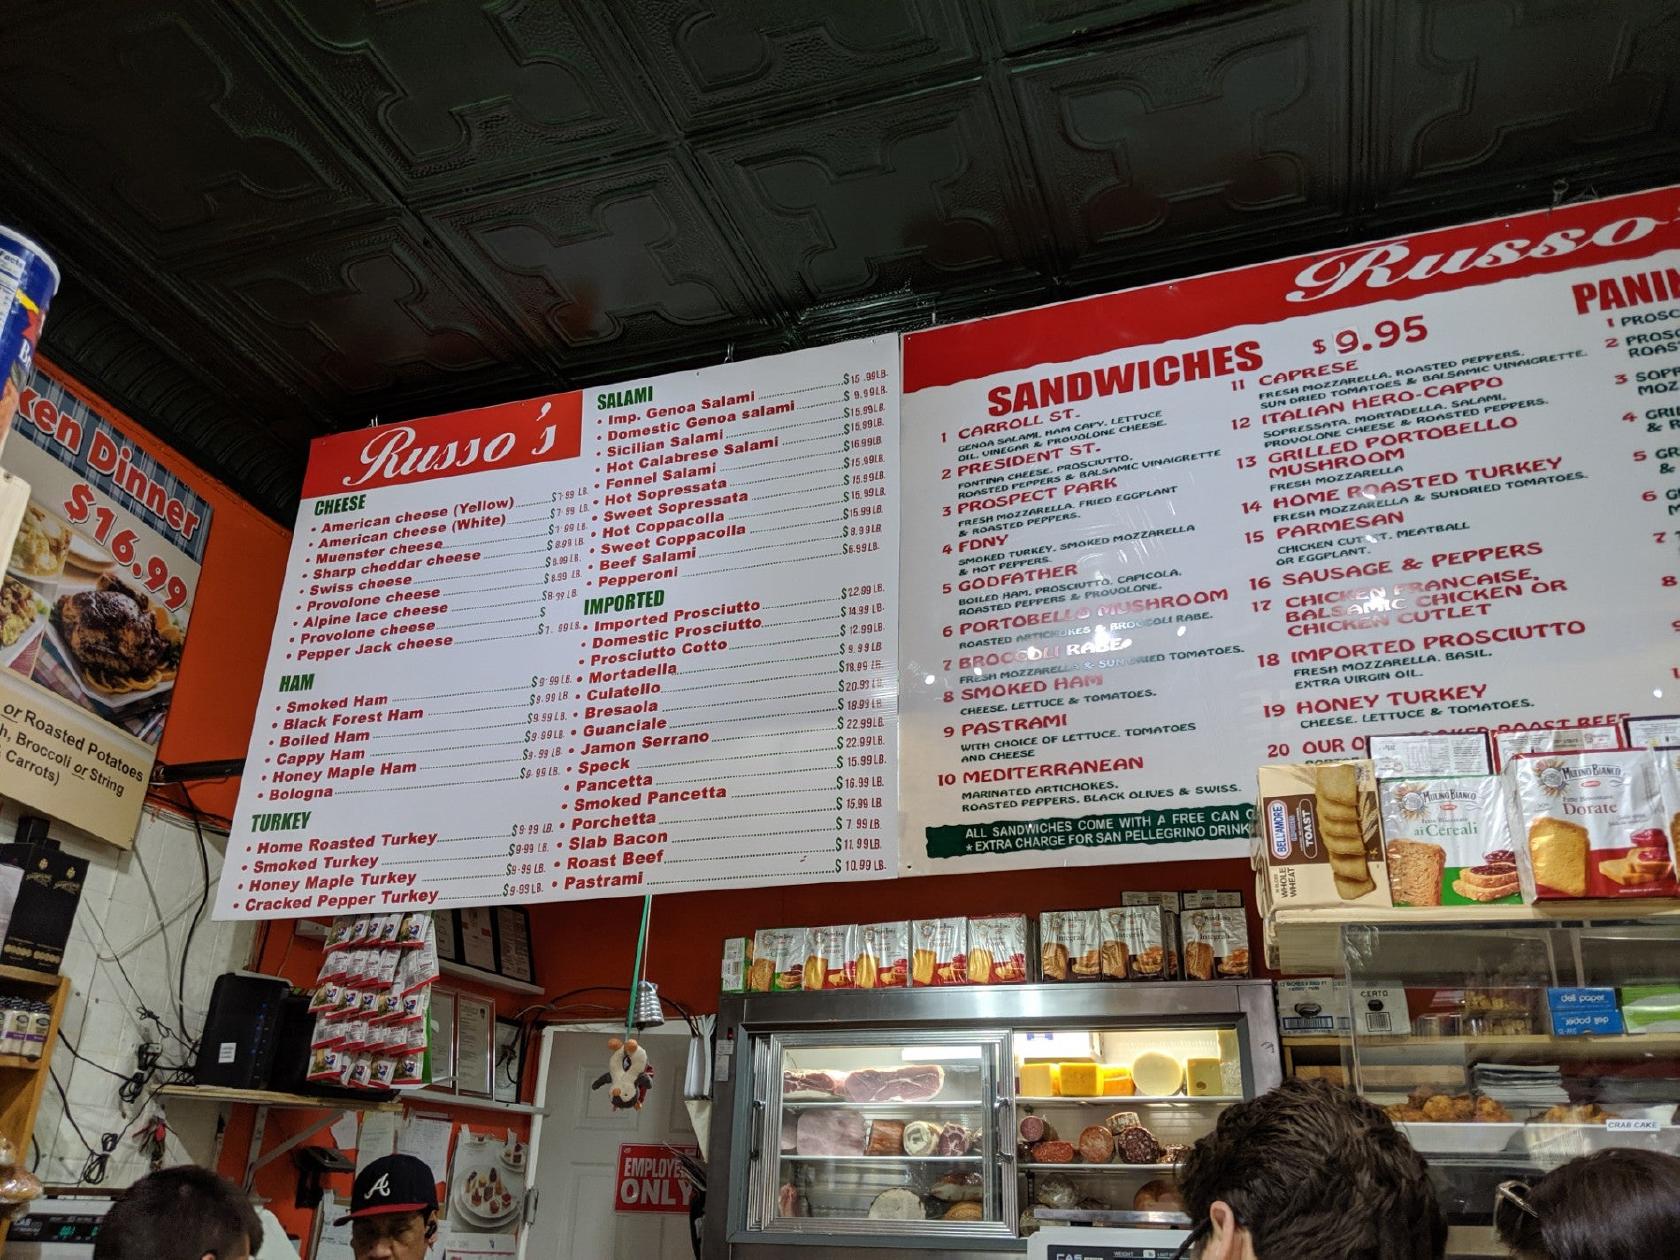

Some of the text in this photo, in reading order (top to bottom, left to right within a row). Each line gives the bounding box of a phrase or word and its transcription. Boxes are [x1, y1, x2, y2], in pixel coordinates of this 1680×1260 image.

[1312, 315, 1429, 355] $9.95
[988, 341, 1263, 417] SANDWICHES
[1259, 360, 1358, 386] CAPRESE
[597, 386, 653, 410] SALAMI
[1260, 379, 1402, 409] SUN DRIED TOMATOES
[1262, 377, 1503, 425] ITALIAN HERO-CAPPO
[608, 391, 755, 425] Imp. Genoa Salami
[608, 400, 795, 441] Domestic Genoa salami
[958, 408, 1080, 439] CARROLL ST.
[958, 410, 1162, 452] GENOA LETTUCE
[1268, 416, 1518, 463] GRILLED PORTOBELLO
[958, 442, 1101, 477] PRESIDENT ST.
[1269, 447, 1405, 478] MUSHROOM
[1633, 451, 1647, 462] 5
[87, 430, 200, 538] Dinner
[958, 484, 1009, 500] ROASTED
[1011, 476, 1061, 490] PEPPERS
[1079, 462, 1138, 478] BALSAMIC
[1273, 457, 1562, 509] HOME ROASTED TURKEY
[314, 494, 366, 516] CHEESE
[603, 492, 748, 522] Sweet Sopressata
[958, 477, 1117, 514] PROSPECT PARK
[1079, 486, 1178, 508] FRIED EGGPLANT
[321, 496, 514, 533] American cheese (Yellow)
[602, 511, 724, 539] Hot Coppacolla
[1277, 511, 1404, 539] PARMESAN
[63, 483, 188, 612] $16.99
[959, 534, 1009, 553] FDNY
[1060, 525, 1195, 550] SMOKED MOZZARELLA
[316, 540, 443, 564] Muenster cheese
[1282, 542, 1543, 586] SAUSAGE & PEPPERS
[598, 566, 678, 588] Pepperoni
[958, 564, 1078, 592] GODFATHER
[1661, 575, 1677, 587] 8
[584, 589, 665, 615] IMPORTED
[960, 588, 1229, 635] PORTOBELLO MUSHROOM
[302, 604, 448, 629] Alpine lace cheese
[594, 600, 760, 632] Imported Prosciutto
[297, 637, 453, 662] Pepper Jack cheese
[1291, 621, 1586, 663] IMPORTED PROSCIUTTO
[589, 662, 676, 684] Mortadella
[1257, 653, 1280, 668] 18
[279, 673, 315, 692] HAM
[587, 683, 660, 701] Culatello
[286, 695, 388, 713] Smoked Ham
[1296, 684, 1487, 714] HONEY TURKEY
[283, 709, 424, 730] Black Forest Ham
[583, 717, 667, 737] Guanciale
[961, 713, 1067, 736] PASTRAMI
[3, 704, 22, 718] or
[24, 709, 86, 752] Roasted
[87, 742, 143, 782] Potatoes
[580, 732, 709, 755] Jamon Serrano
[960, 722, 1196, 752] WITH CHOICE OF TOMATOES
[1267, 743, 1290, 758] 20
[6, 749, 60, 786] Carrots)
[16, 732, 72, 768] Broccoli
[89, 767, 125, 798] String
[578, 757, 630, 776] Speck
[963, 757, 1143, 784] MEDITERRANEAN
[938, 773, 956, 786] 10
[574, 786, 726, 812] Smoked Pancetta
[1563, 802, 1617, 816] Dorate
[251, 811, 312, 833] TURKEY
[966, 810, 1239, 838] ALL SANDWICHES COME WITH A FREE CAN
[1302, 809, 1315, 847] TOAST
[1015, 835, 1065, 848] CHARGE
[1068, 833, 1093, 844] FOR
[1096, 831, 1121, 843] SAN
[1125, 826, 1205, 841] PELLEGRINO
[564, 871, 643, 890] Pastrami
[1280, 867, 1288, 898] WHOLE
[1287, 867, 1297, 898] WHEAT
[245, 889, 440, 912] Cracked Pepper Turkey
[1560, 993, 1605, 1004] deli paper
[1608, 1121, 1657, 1129] CRAB CAKE
[623, 1157, 684, 1178] EMPLOYE
[620, 1178, 693, 1206] ONLY
